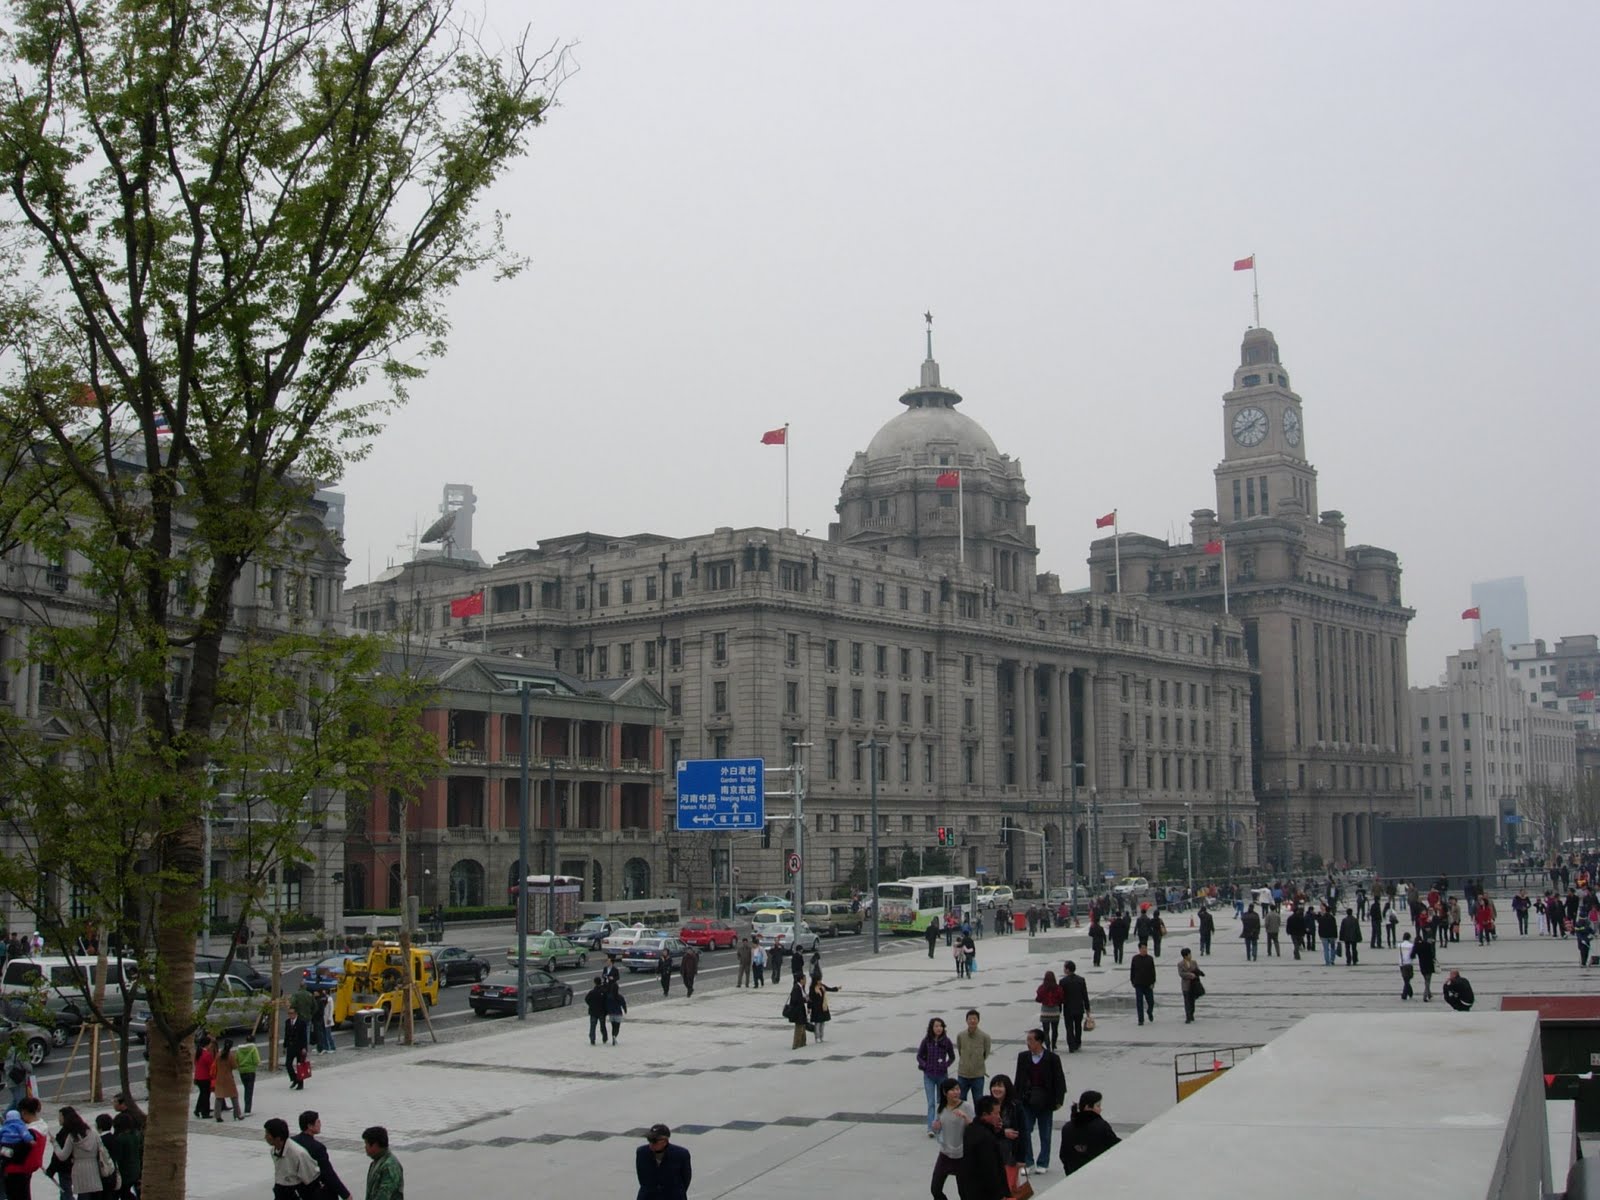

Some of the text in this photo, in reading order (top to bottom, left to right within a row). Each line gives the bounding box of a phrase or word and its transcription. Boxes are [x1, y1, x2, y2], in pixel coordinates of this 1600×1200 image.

[720, 766, 756, 775] 外白渡桥
[720, 785, 756, 795] 南京东路
[680, 793, 716, 803] 河南中路
